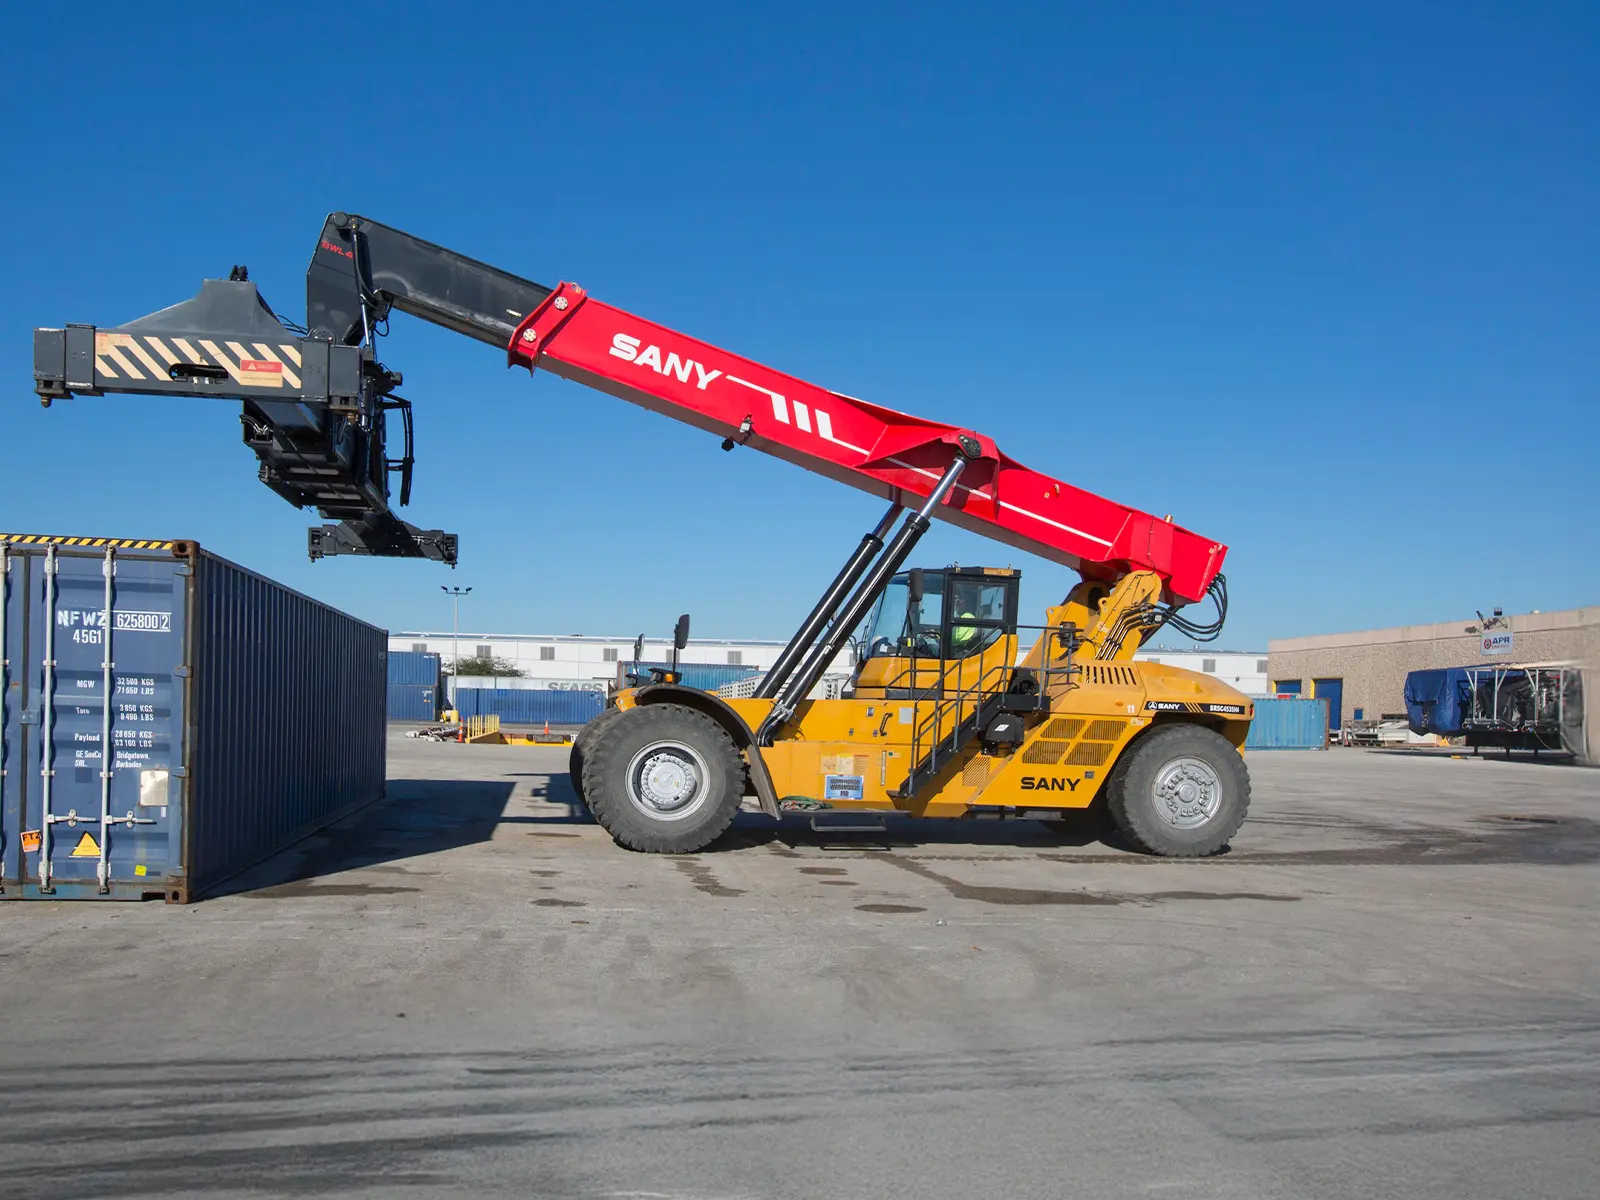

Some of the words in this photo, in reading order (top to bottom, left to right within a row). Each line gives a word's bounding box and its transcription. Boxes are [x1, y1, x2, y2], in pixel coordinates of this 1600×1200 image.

[609, 333, 723, 390] SANY
[73, 628, 102, 644] 45G1
[1492, 636, 1510, 644] APR
[76, 680, 95, 688] MGW
[141, 678, 155, 686] KGS
[141, 687, 155, 695] LBS
[1158, 702, 1180, 710] SANY
[74, 733, 100, 742] Payload
[139, 731, 153, 739] KGS
[139, 740, 153, 748] LBS
[75, 750, 84, 759] GE
[1021, 776, 1081, 792] SANY
